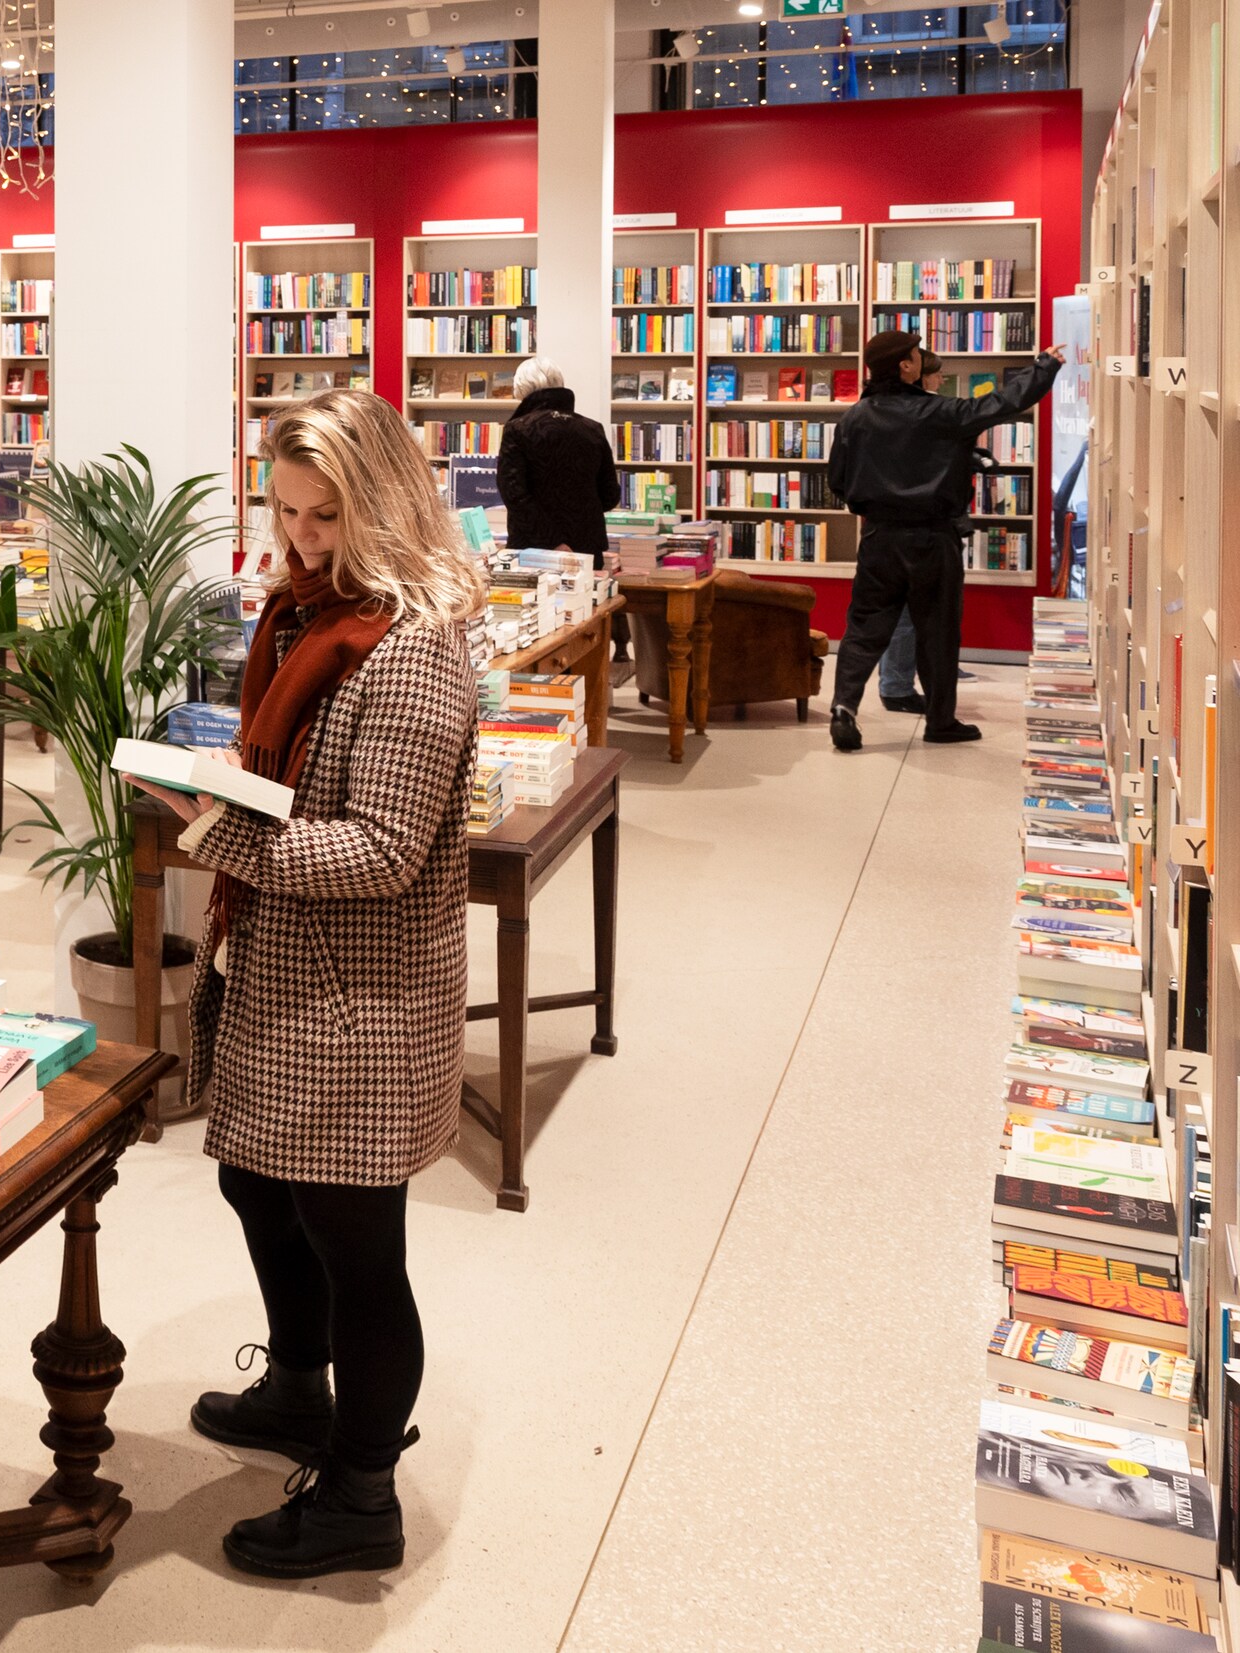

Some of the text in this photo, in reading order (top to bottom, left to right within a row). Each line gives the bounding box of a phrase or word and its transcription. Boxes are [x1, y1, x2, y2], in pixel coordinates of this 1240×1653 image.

[1098, 271, 1108, 280] O
[1113, 362, 1122, 372] S
[1148, 720, 1159, 735] U
[1129, 780, 1140, 793] T
[1138, 826, 1152, 840] V
[1185, 838, 1207, 859] Y
[7, 1050, 27, 1064] Spit
[1179, 1064, 1198, 1085] Z
[1035, 1456, 1048, 1477] HANYA
[1152, 1480, 1171, 1512] LEVEN
[1173, 1475, 1190, 1496] EEN
[1175, 1496, 1195, 1528] KLEIN
[990, 1534, 1001, 1580] BANANA YOSHIMOTO
[1006, 1575, 1189, 1628] KITCHEN
[1015, 1603, 1025, 1647] ALS SAMOERA
[1030, 1598, 1043, 1642] DE SCHRIJVER
[1050, 1602, 1062, 1653] ALEX BOOGER
